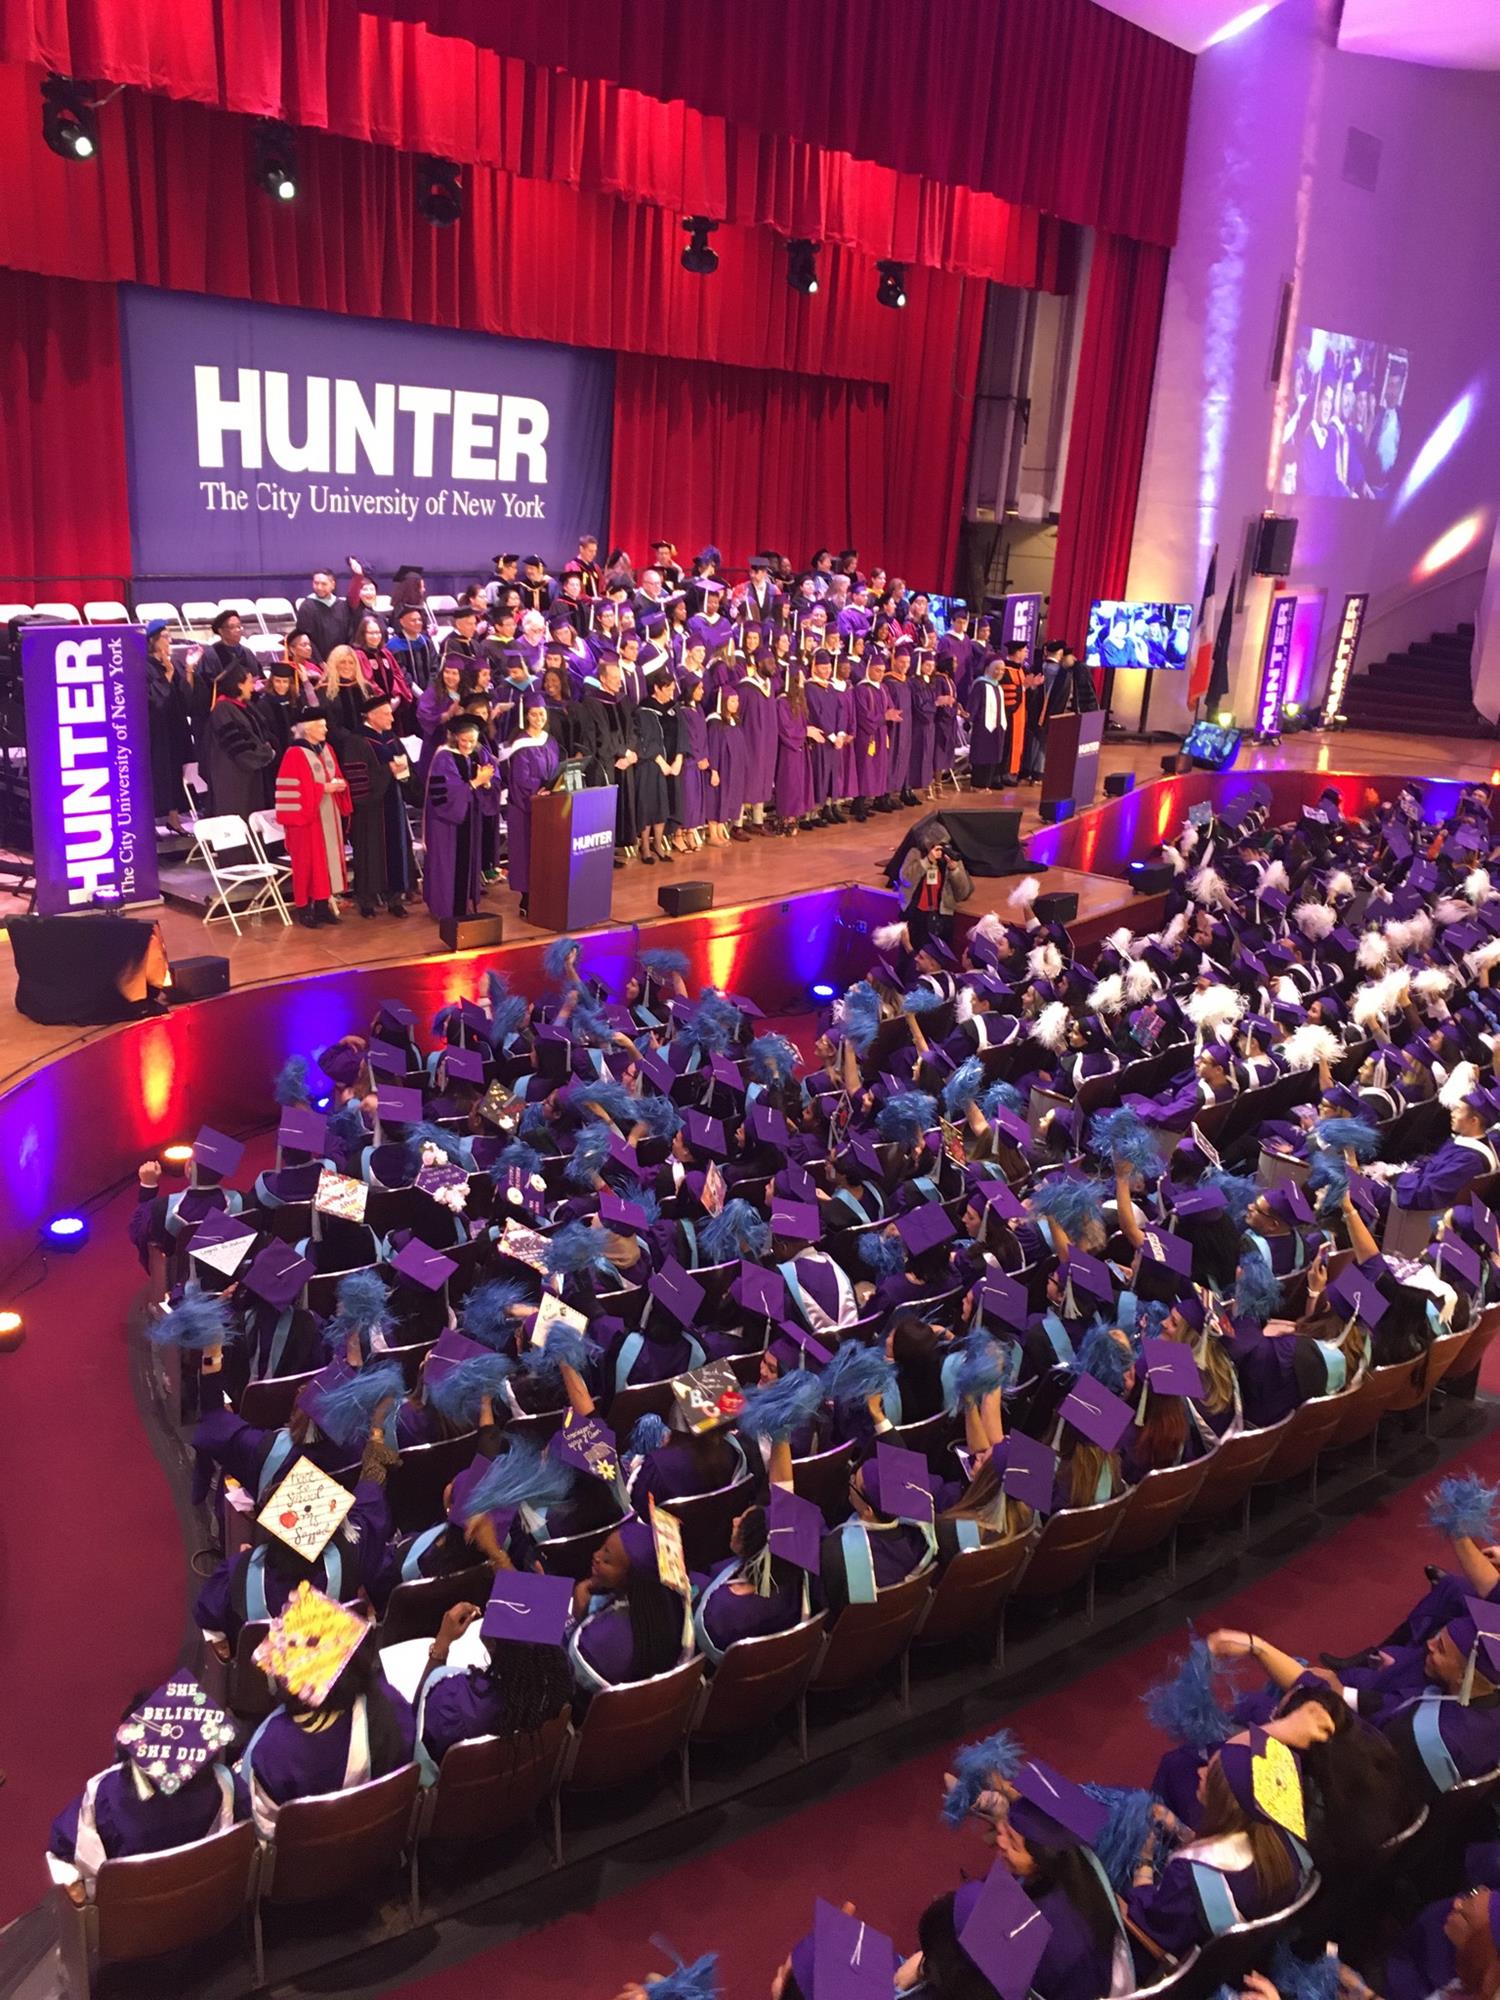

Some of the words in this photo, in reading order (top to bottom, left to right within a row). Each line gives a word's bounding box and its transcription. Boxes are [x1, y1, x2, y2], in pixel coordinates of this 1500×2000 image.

[194, 365, 550, 483] HUNTER
[200, 482, 249, 511] The
[256, 482, 301, 519] City
[309, 486, 420, 522] University
[426, 489, 448, 515] of
[452, 490, 496, 516] New
[502, 493, 545, 519] York
[108, 637, 124, 676] York
[112, 680, 126, 720] New
[116, 721, 128, 740] of
[55, 637, 114, 905] HUNTER
[115, 743, 133, 828] University
[119, 831, 137, 867] City
[574, 830, 612, 850] HUNTER
[121, 868, 137, 899] The
[166, 1683, 198, 1697] SHE
[143, 1707, 225, 1723] BELIEVED
[160, 1723, 184, 1739] SO
[137, 1744, 170, 1759] SHE
[176, 1747, 207, 1762] DID
